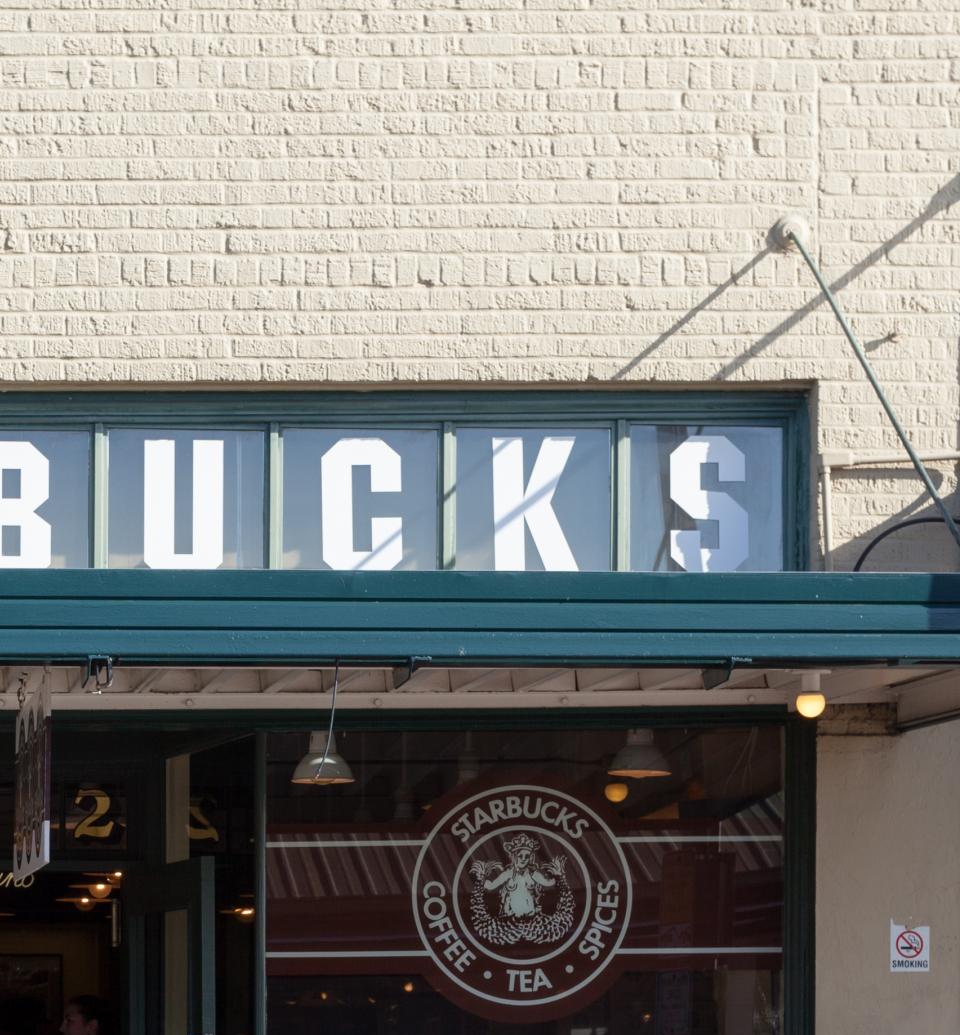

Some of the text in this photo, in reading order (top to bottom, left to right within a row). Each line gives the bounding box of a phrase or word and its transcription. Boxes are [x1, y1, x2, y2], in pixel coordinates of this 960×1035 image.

[451, 796, 590, 843] STARBUCKS
[423, 881, 477, 973] COFFEE
[578, 879, 620, 961] SPICES
[506, 969, 553, 993] TEA
[892, 960, 929, 969] SMOKING
